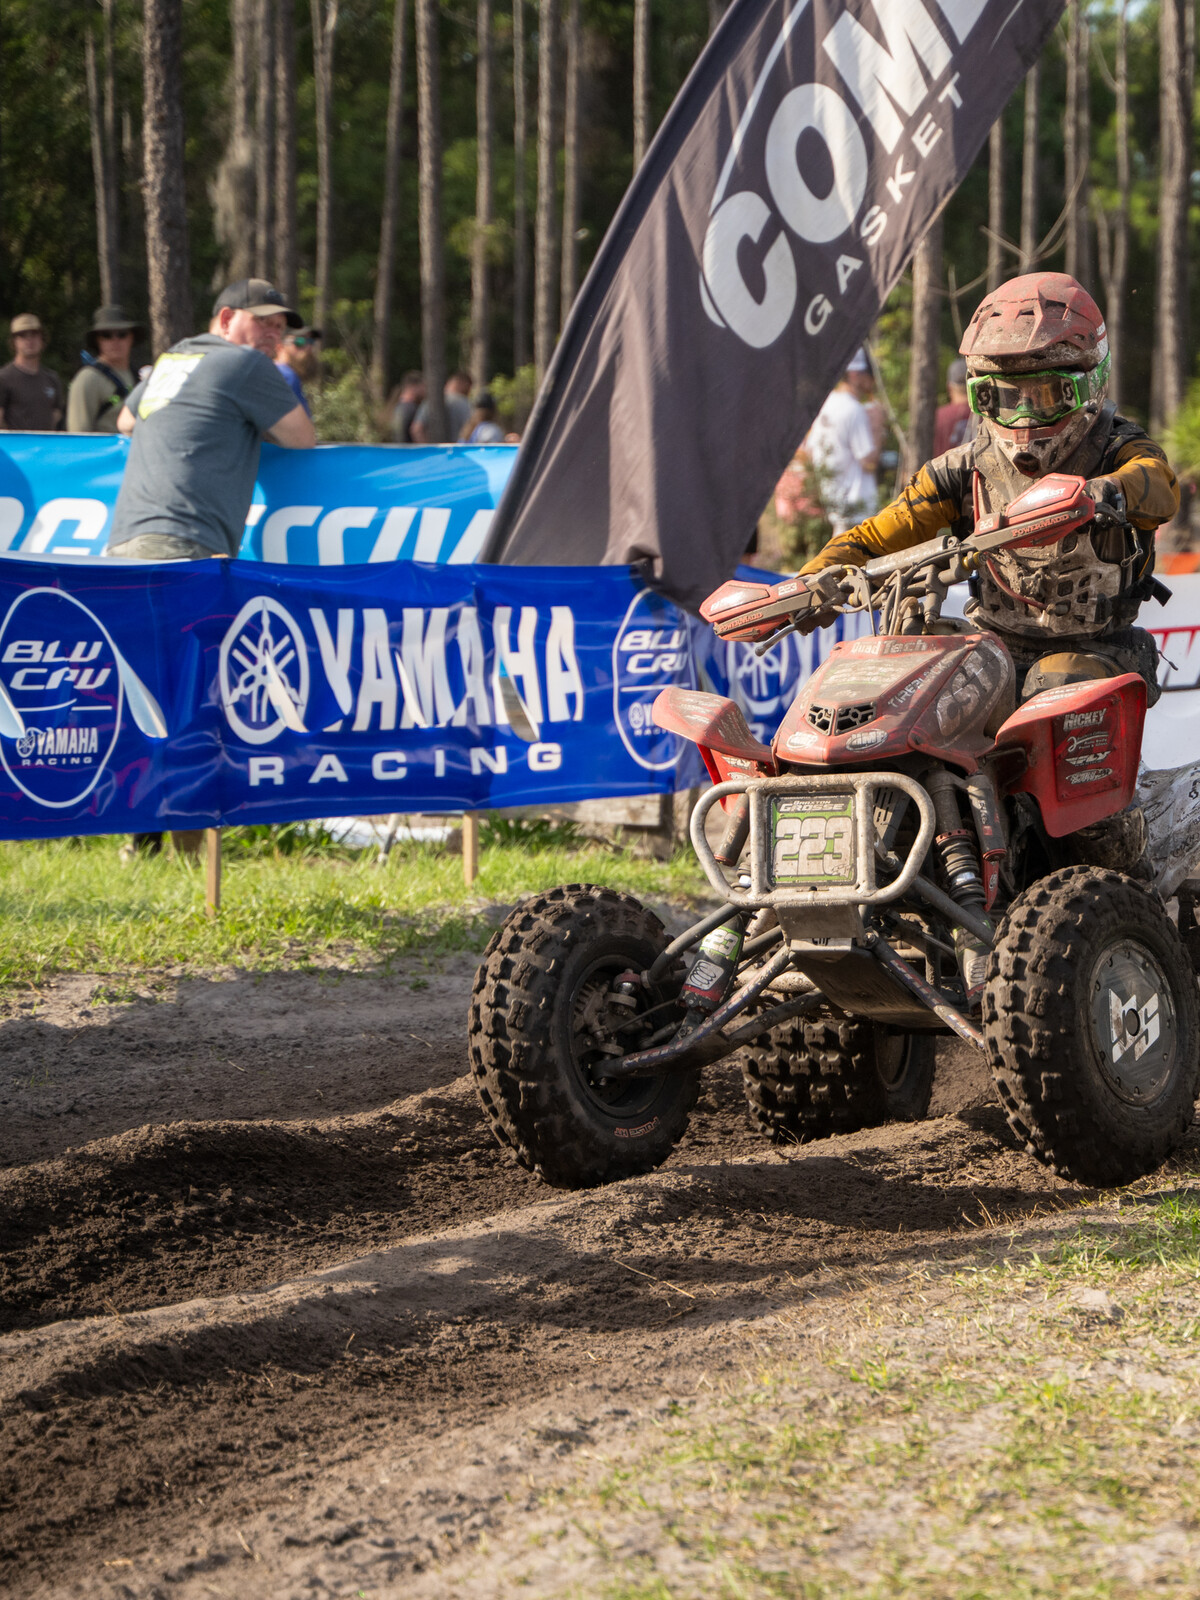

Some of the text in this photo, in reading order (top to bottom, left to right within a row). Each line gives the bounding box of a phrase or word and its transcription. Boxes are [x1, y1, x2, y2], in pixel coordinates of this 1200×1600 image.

[703, 0, 988, 349] COM
[804, 72, 964, 336] GASKET
[1011, 514, 1070, 537] POWERMADD
[2, 641, 102, 663] BLU
[620, 630, 686, 651] BLU
[851, 639, 928, 657] Quad Tech
[308, 605, 584, 732] YAMAHA
[626, 652, 690, 673] CRU
[1063, 708, 1107, 731] HICKEY
[37, 727, 98, 755] YAMAHA
[21, 756, 93, 767] RACING
[249, 742, 562, 787] RACING
[780, 803, 845, 811] GROSSE
[773, 816, 853, 876] 223
